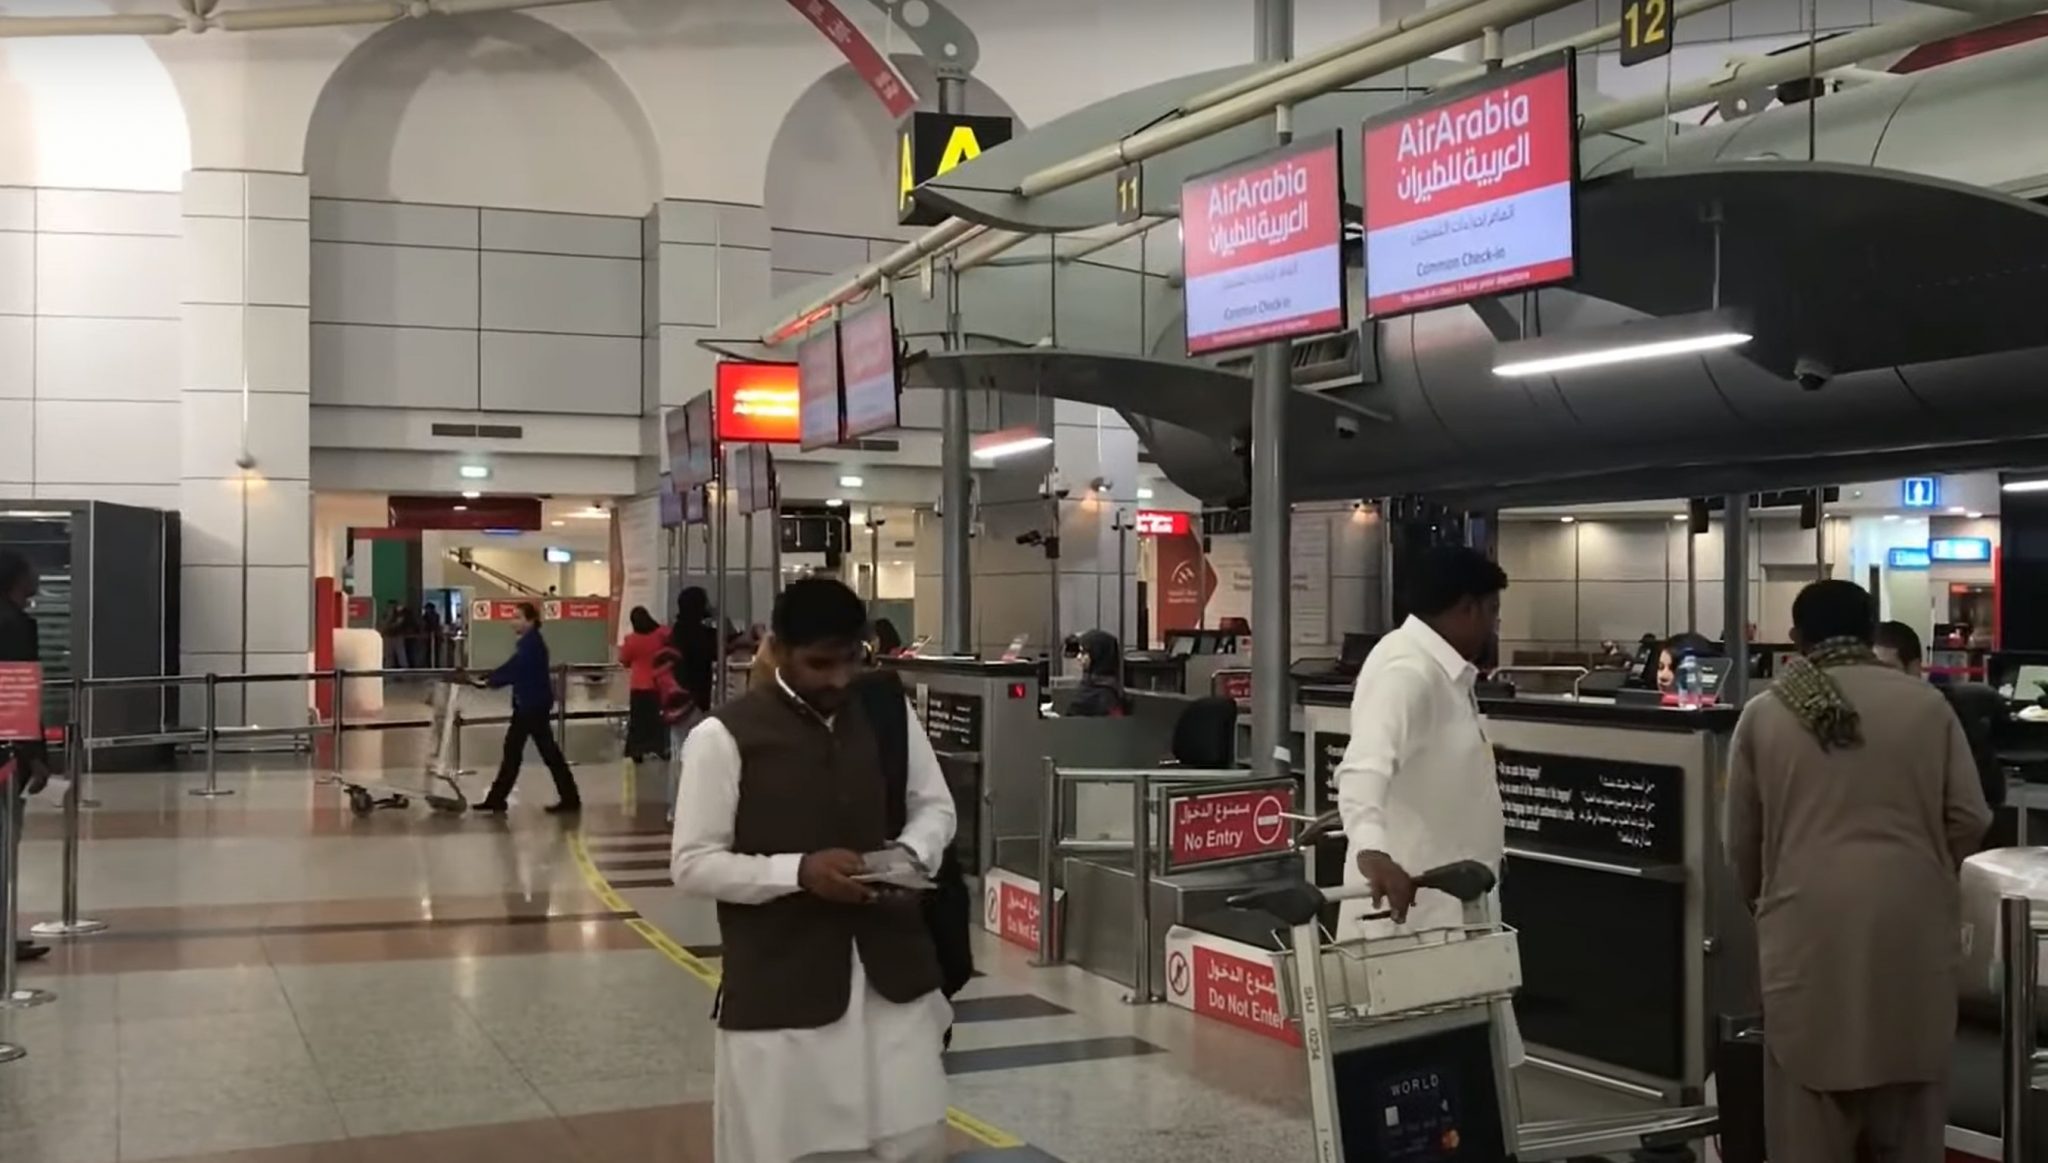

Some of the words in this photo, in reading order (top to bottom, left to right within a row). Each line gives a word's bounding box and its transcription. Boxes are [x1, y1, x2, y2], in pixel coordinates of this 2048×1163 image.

[1625, 0, 1666, 48] 12
[1397, 90, 1529, 162] AirArabia
[900, 133, 914, 211] A
[1397, 152, 1461, 204] للطيران
[1463, 132, 1530, 188] العربية
[1119, 176, 1137, 213] 11
[1208, 163, 1307, 221] AirArabia
[1208, 216, 1257, 257] للطيران
[1258, 200, 1308, 246] العربية
[1180, 803, 1213, 825] الدخول
[1214, 802, 1250, 823] ممنوع
[1184, 833, 1203, 851] No
[1206, 829, 1244, 848] Entry
[1208, 959, 1244, 982] الدخول
[1246, 972, 1276, 996] منوع
[1209, 987, 1225, 1010] Do
[1228, 996, 1249, 1019] Not
[1252, 1001, 1285, 1030] Enter
[1390, 1073, 1440, 1096] WORLD
